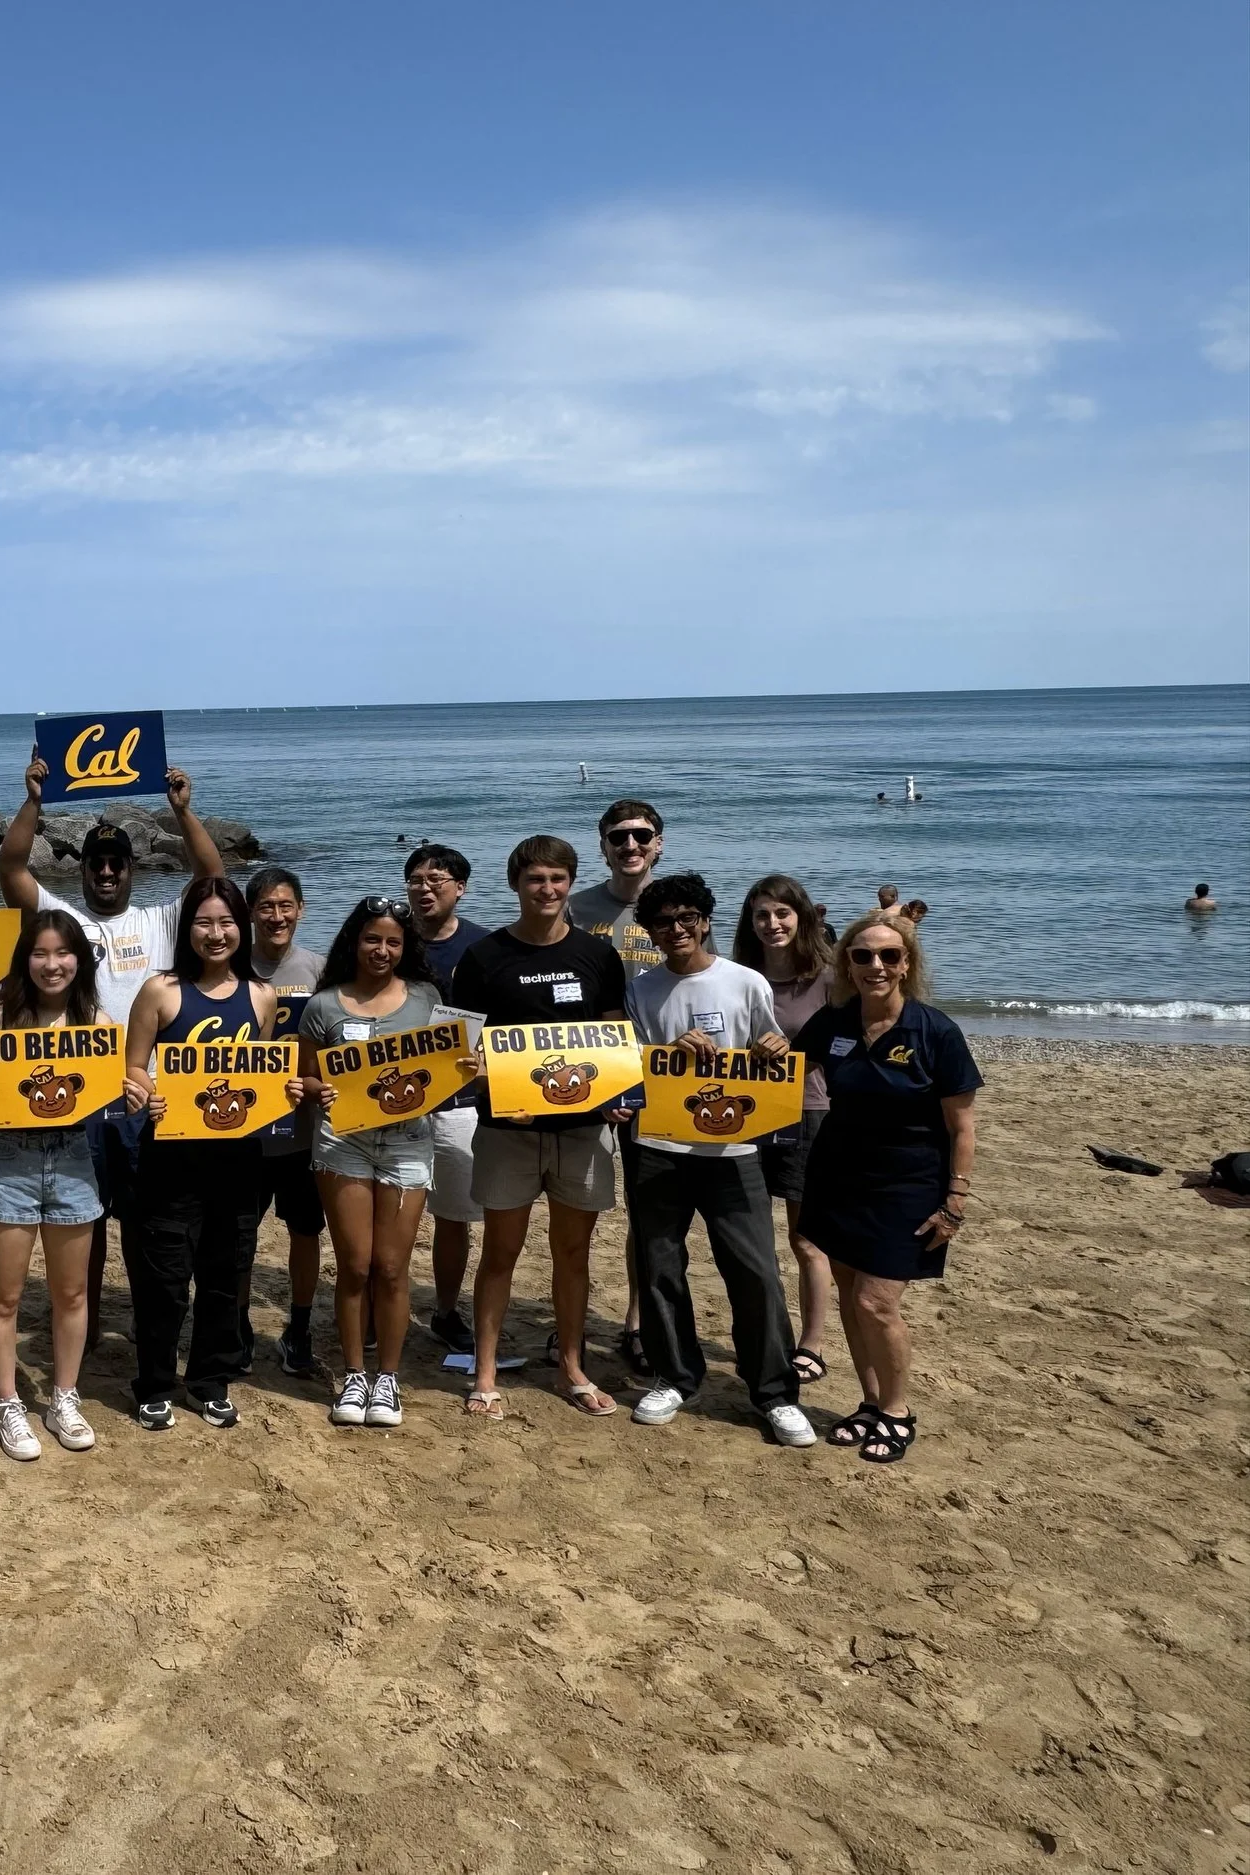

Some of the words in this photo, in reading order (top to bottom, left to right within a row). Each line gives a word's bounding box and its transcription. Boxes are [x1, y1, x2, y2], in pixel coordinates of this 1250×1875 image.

[64, 724, 141, 792] Cal
[97, 826, 117, 840] Cal
[24, 1028, 118, 1061] BEARS!
[326, 1046, 362, 1076] GO
[366, 1024, 461, 1067] BEARS!
[491, 1028, 527, 1053] GO
[532, 1024, 628, 1051] BEARS!
[164, 1046, 197, 1074] GO
[204, 1046, 291, 1074] BEARS!
[886, 1045, 914, 1064] Cal
[547, 1061, 565, 1073] CAL
[650, 1049, 687, 1077] GO
[695, 1051, 796, 1084] BEARS!
[35, 1072, 54, 1085] CAL
[382, 1073, 400, 1086] CAL
[703, 1091, 723, 1102] CAL
